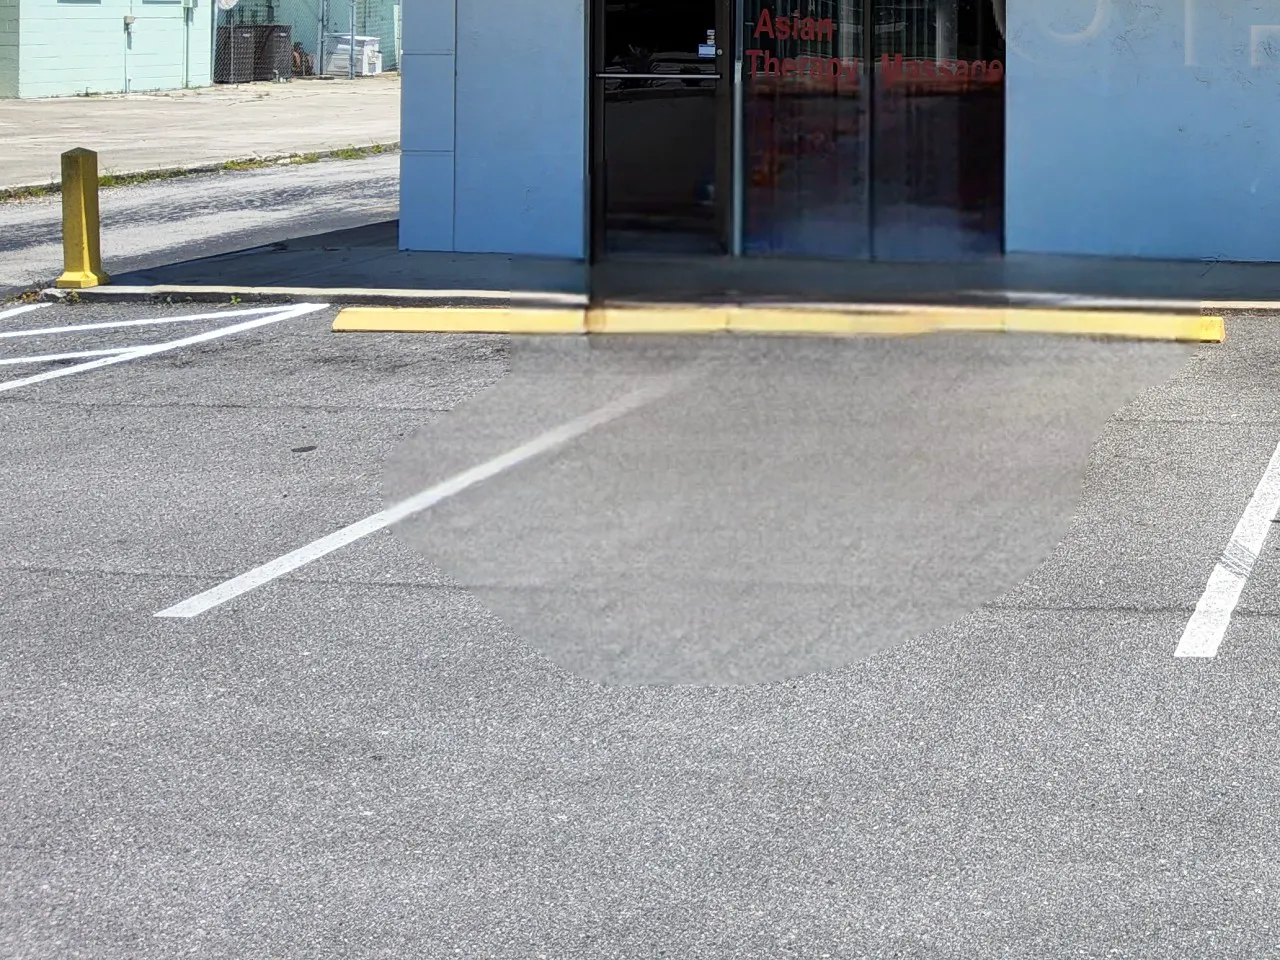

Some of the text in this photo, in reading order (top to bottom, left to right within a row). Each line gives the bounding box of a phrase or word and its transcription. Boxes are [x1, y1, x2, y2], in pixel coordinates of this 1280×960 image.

[753, 8, 835, 42] Asian
[745, 49, 1004, 88] Therapy Massage
